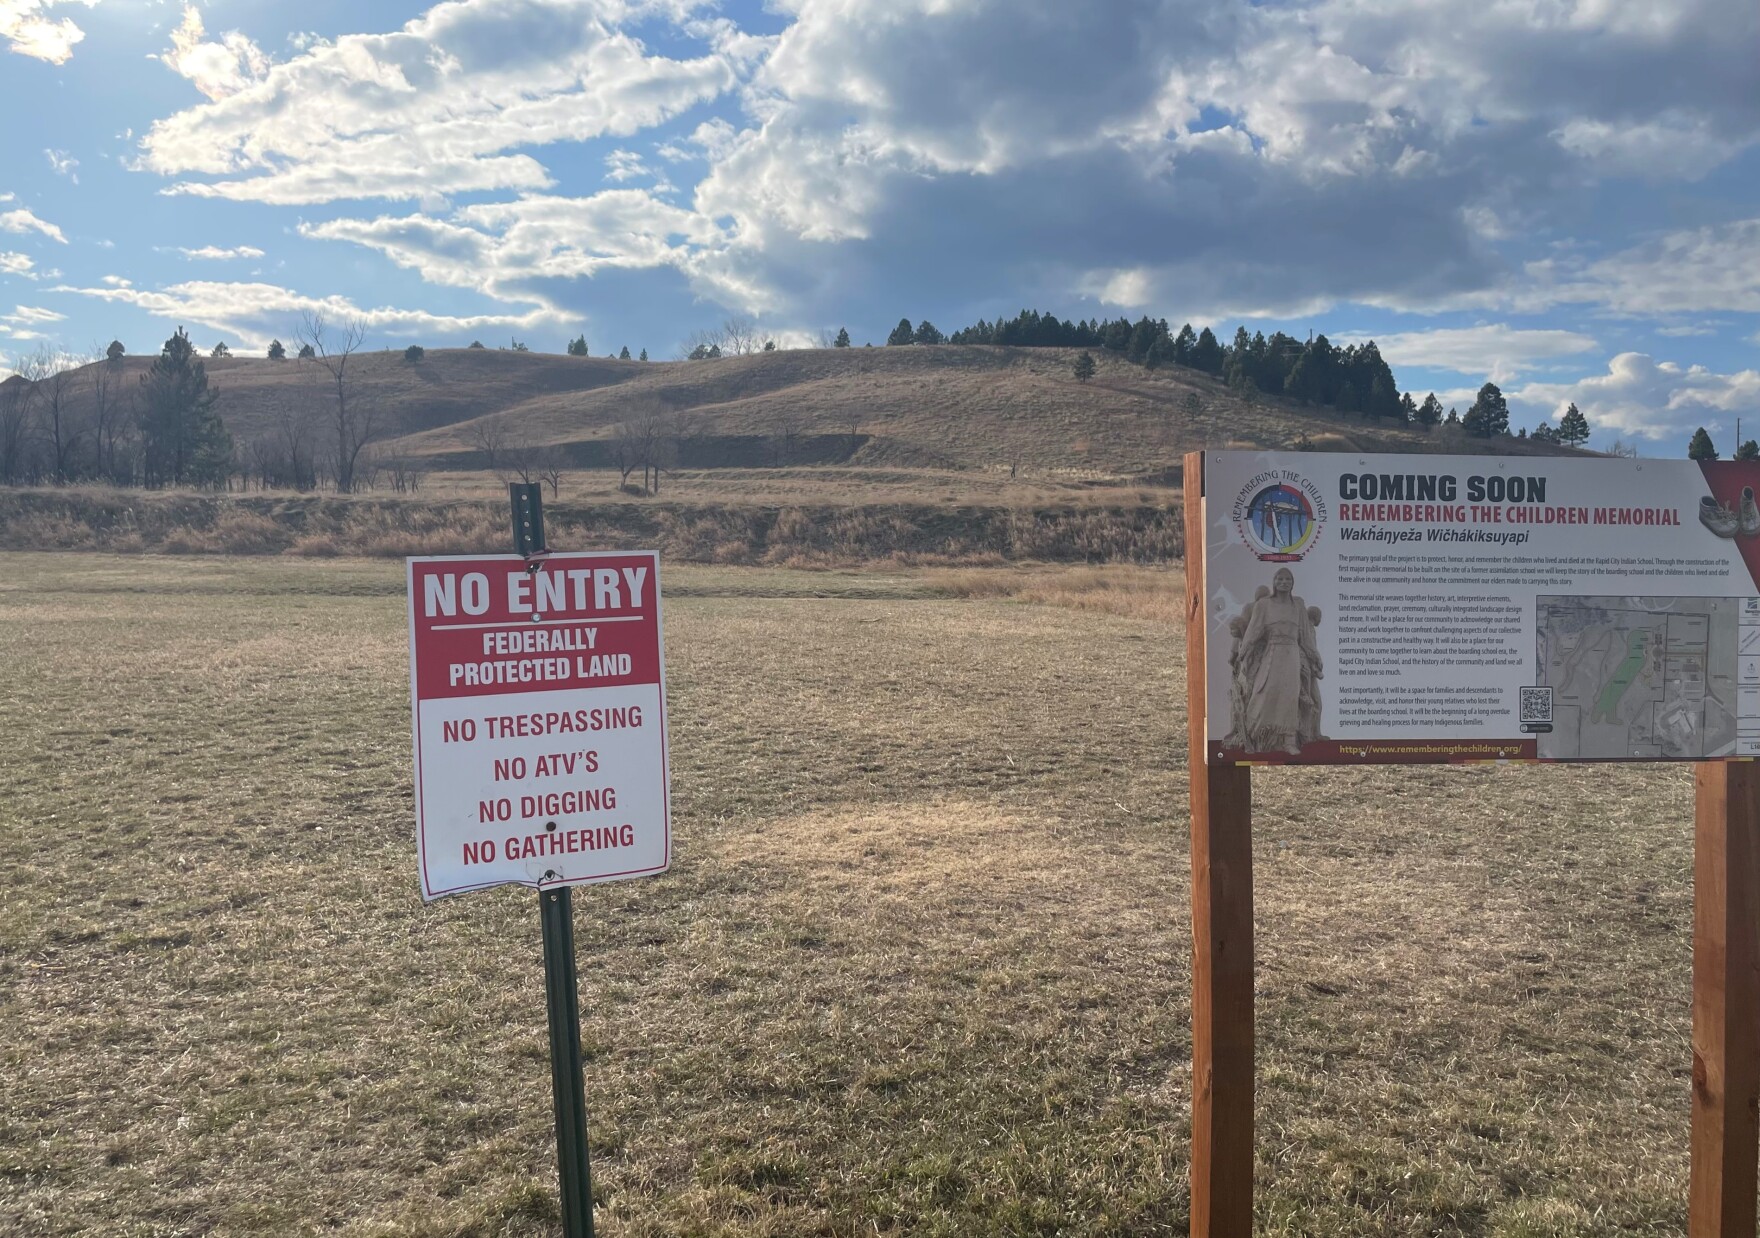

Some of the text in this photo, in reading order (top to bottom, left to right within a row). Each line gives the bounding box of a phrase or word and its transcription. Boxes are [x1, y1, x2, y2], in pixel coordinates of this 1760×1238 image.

[1339, 474, 1546, 502] COMING SOON
[1233, 470, 1327, 522] REMEMBERING THE CHILDREN
[1340, 504, 1680, 526] REMEMBERING THE CHILDREN MEMORIAL
[1349, 555, 1369, 564] primary
[1370, 555, 1381, 564] goal
[1398, 555, 1416, 564] project
[1595, 557, 1610, 566] Rapid
[1610, 557, 1620, 566] City
[1655, 558, 1675, 567] Through
[1350, 565, 1365, 574] major
[1366, 565, 1381, 574] public
[1555, 567, 1567, 576] keep
[1577, 568, 1590, 576] story
[1606, 568, 1628, 577] boarding
[1382, 576, 1410, 585] community
[1528, 578, 1548, 586] carrying
[424, 567, 648, 616] NO ENTRY
[1405, 594, 1427, 603] together
[1457, 594, 1486, 603] interpretive
[1428, 605, 1452, 614] culturally
[1453, 605, 1479, 614] integrated
[1479, 606, 1504, 614] landscape
[1505, 606, 1522, 614] design
[1392, 615, 1406, 624] place
[1424, 616, 1453, 624] community
[1460, 616, 1493, 625] acknowledge
[1339, 626, 1356, 634] history
[1382, 626, 1404, 635] together
[1433, 626, 1463, 635] challenging
[1463, 626, 1482, 635] aspects
[483, 628, 597, 655] FEDERALLY
[1339, 636, 1350, 645] past
[1403, 637, 1422, 646] healthy
[1473, 637, 1486, 646] place
[1339, 647, 1368, 656] community
[1390, 647, 1412, 656] together
[1458, 648, 1481, 656] boarding
[1339, 658, 1354, 667] Rapid
[1354, 658, 1364, 667] City
[1382, 658, 1401, 667] School,
[1422, 658, 1439, 667] history
[1456, 658, 1484, 667] community
[450, 654, 632, 686] PROTECTED LAND
[1353, 687, 1384, 696] importantly,
[1340, 698, 1374, 706] acknowledge,
[1367, 708, 1390, 717] boarding
[1441, 708, 1467, 717] beginning
[1478, 708, 1490, 717] long
[444, 706, 642, 742] NO TRESPASSING
[1340, 719, 1360, 728] grieving
[1372, 719, 1391, 728] healing
[1434, 719, 1462, 728] Indigenous
[494, 757, 526, 781] NO
[480, 788, 616, 823] NO DIGGING
[463, 824, 634, 865] NO GATHERING
